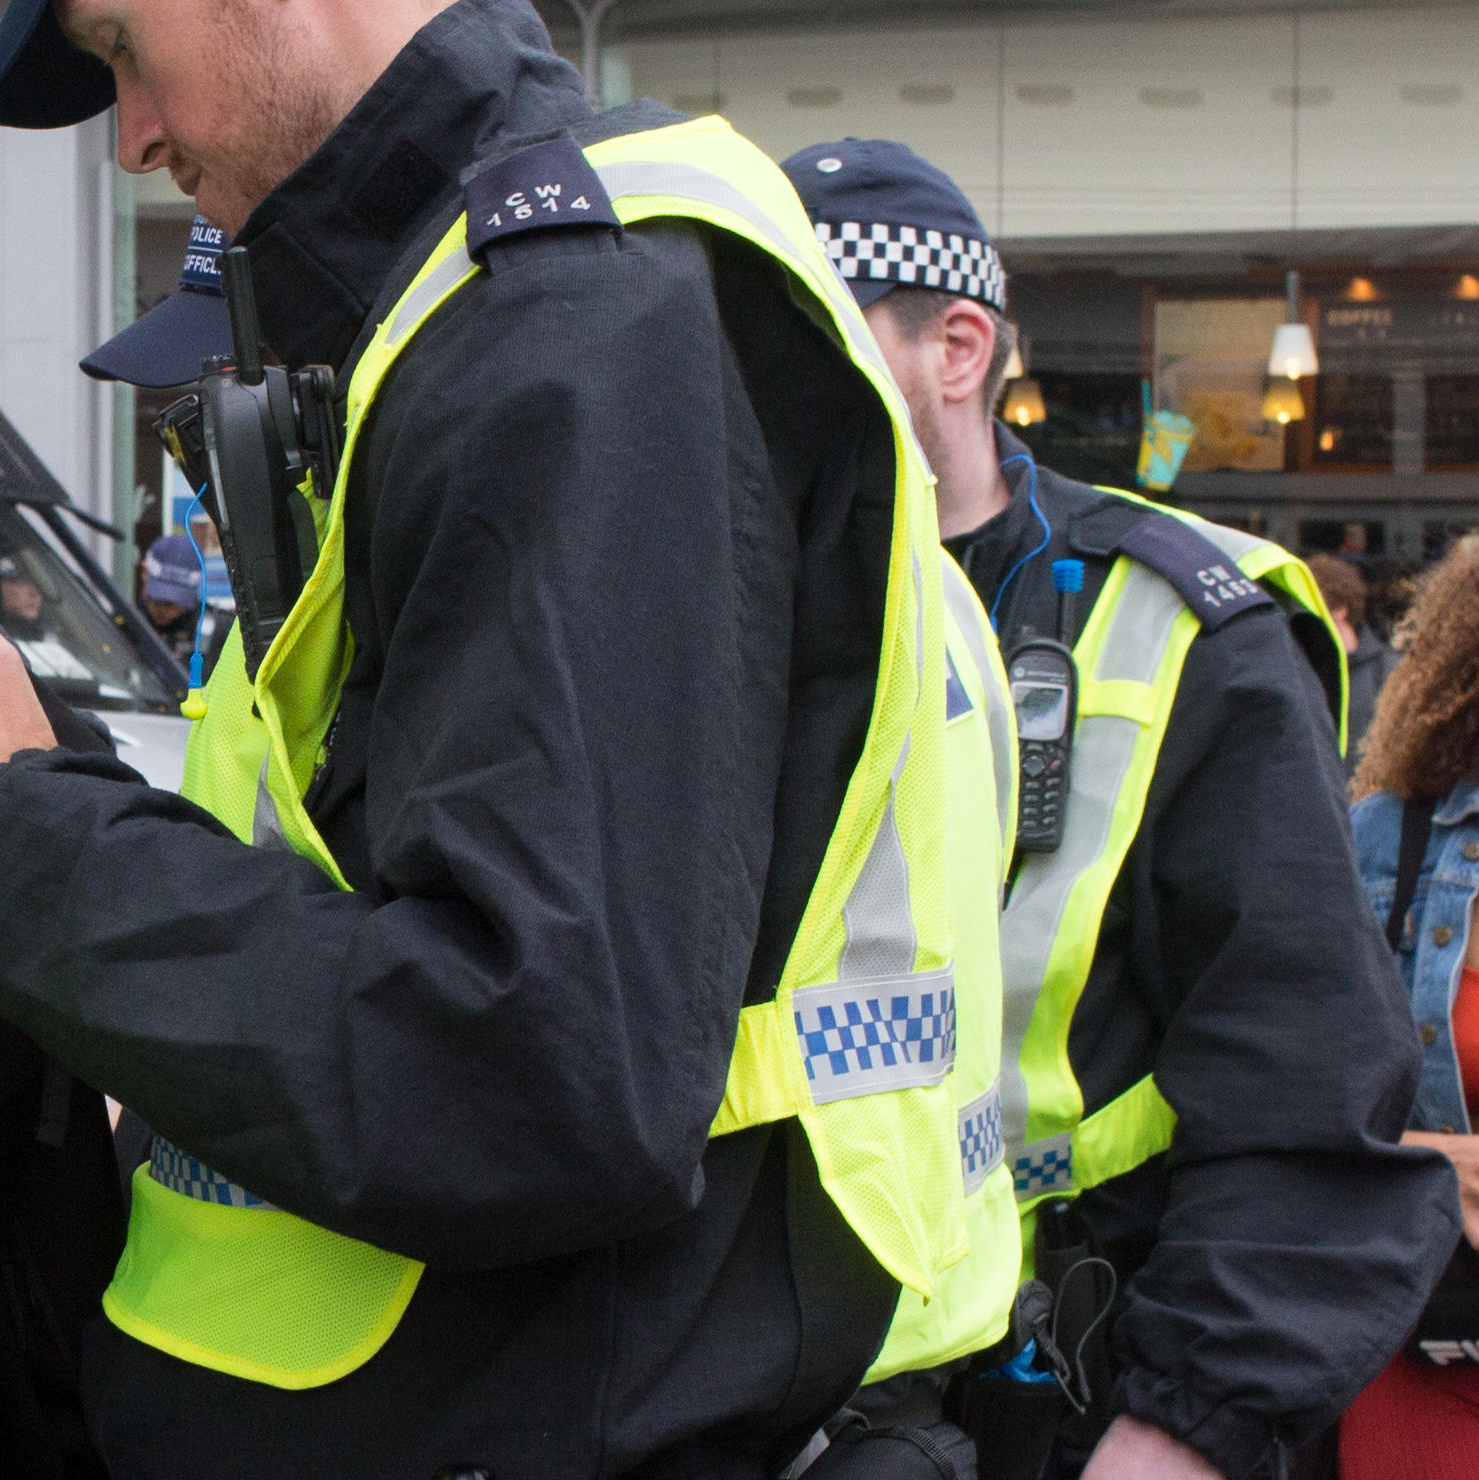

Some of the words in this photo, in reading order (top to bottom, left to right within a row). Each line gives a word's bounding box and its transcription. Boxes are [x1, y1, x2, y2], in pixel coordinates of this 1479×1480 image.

[505, 182, 562, 208] CW
[486, 196, 592, 229] 1514
[190, 226, 223, 244] OLICE
[1197, 565, 1231, 586] CW
